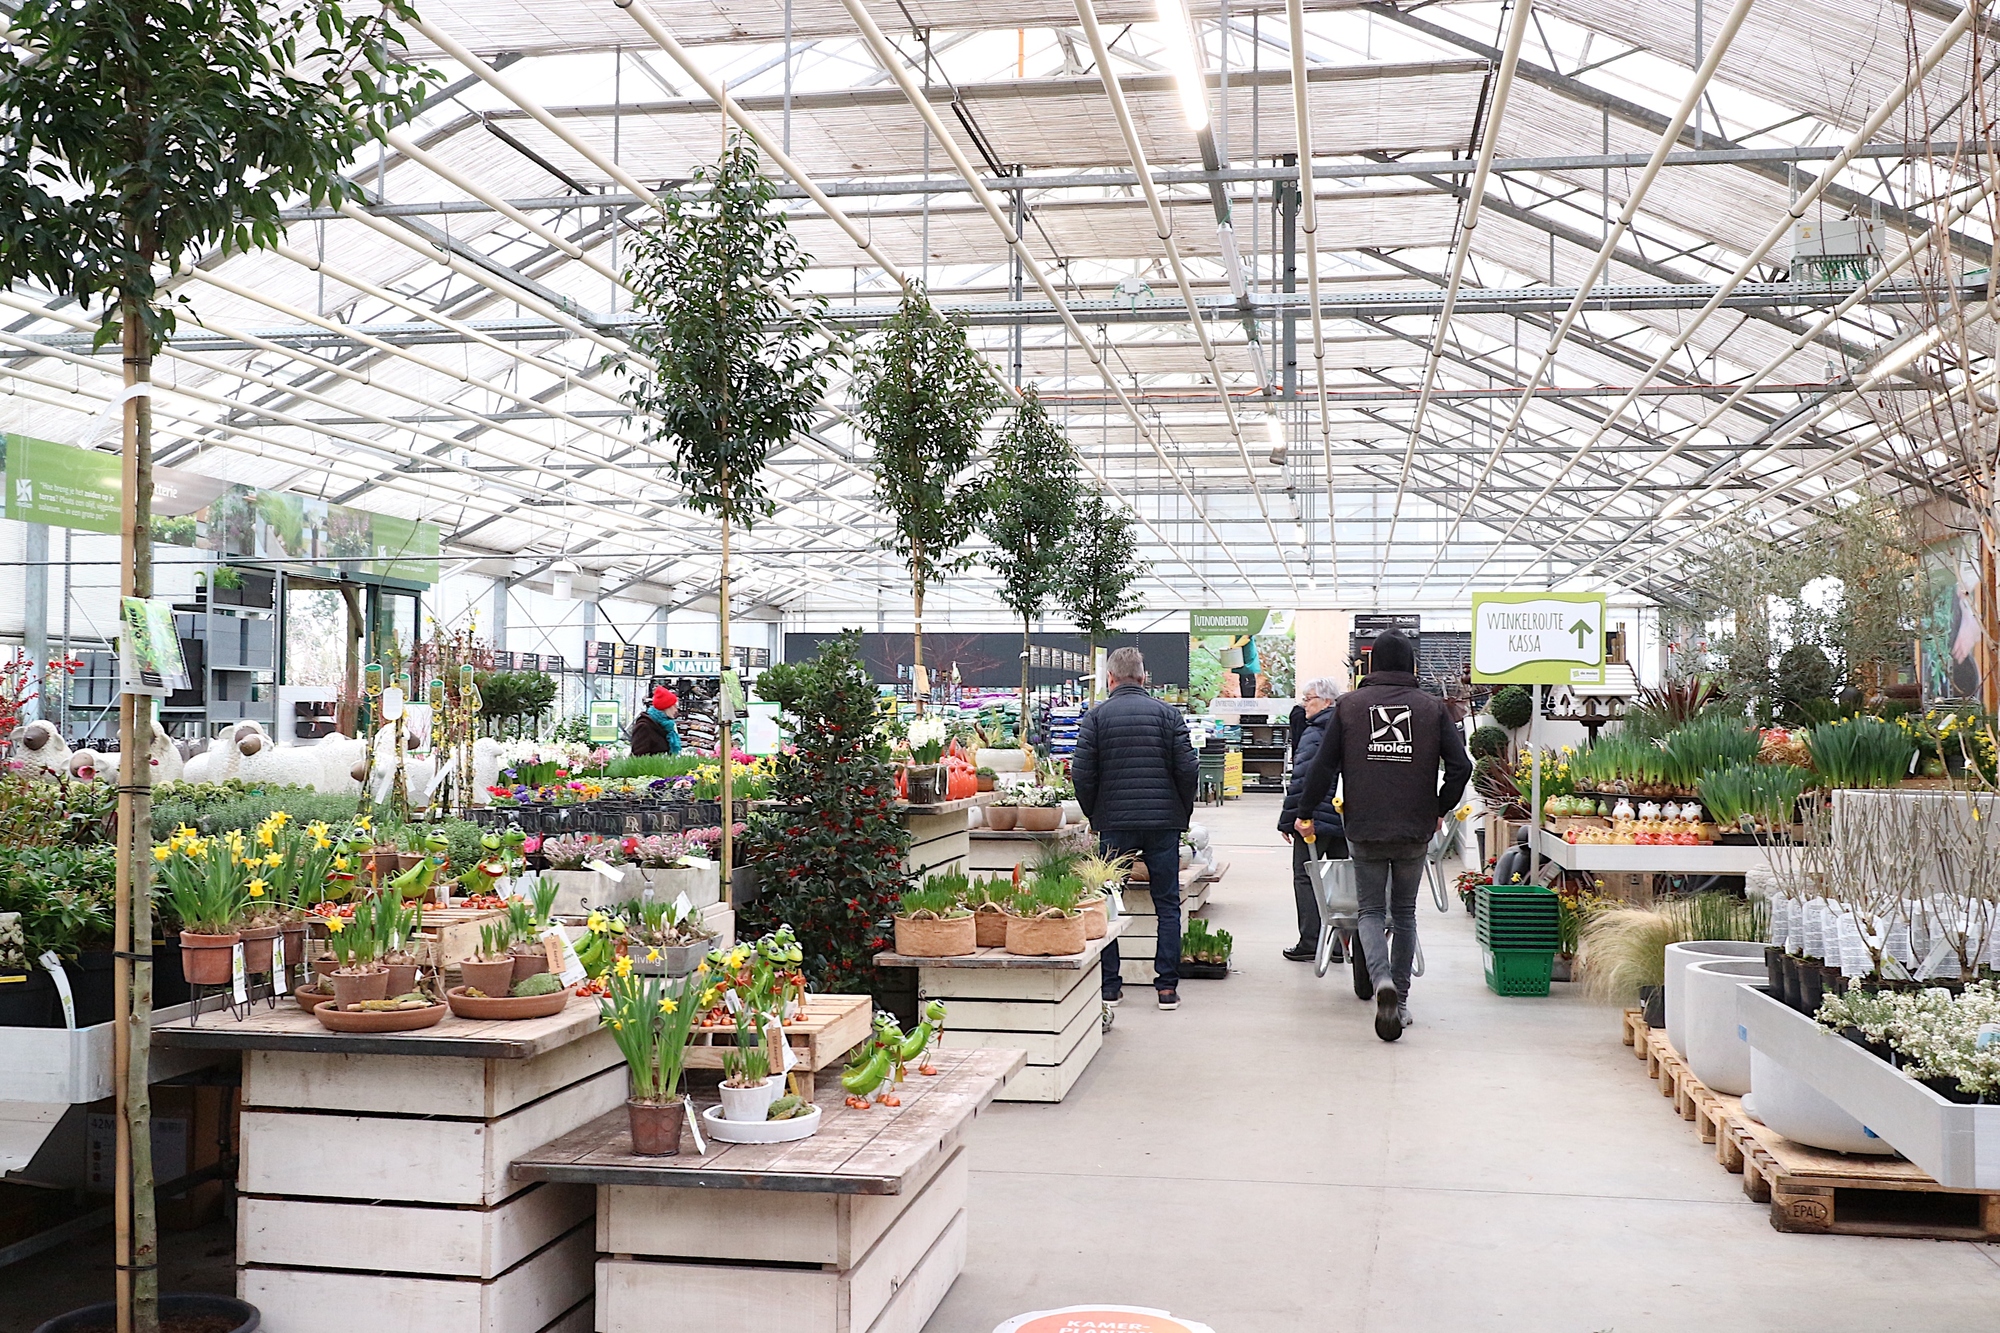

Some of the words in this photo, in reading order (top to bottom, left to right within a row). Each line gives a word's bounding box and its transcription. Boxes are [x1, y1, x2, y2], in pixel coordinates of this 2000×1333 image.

[1193, 614, 1249, 627] TUINONDERHOUD
[1486, 612, 1564, 631] WINKELROUTE
[1508, 634, 1542, 653] KASSA
[675, 660, 722, 673] NATUR
[1373, 742, 1413, 754] molen
[1793, 1205, 1820, 1218] EPAL
[1067, 1320, 1151, 1330] KAMER-
